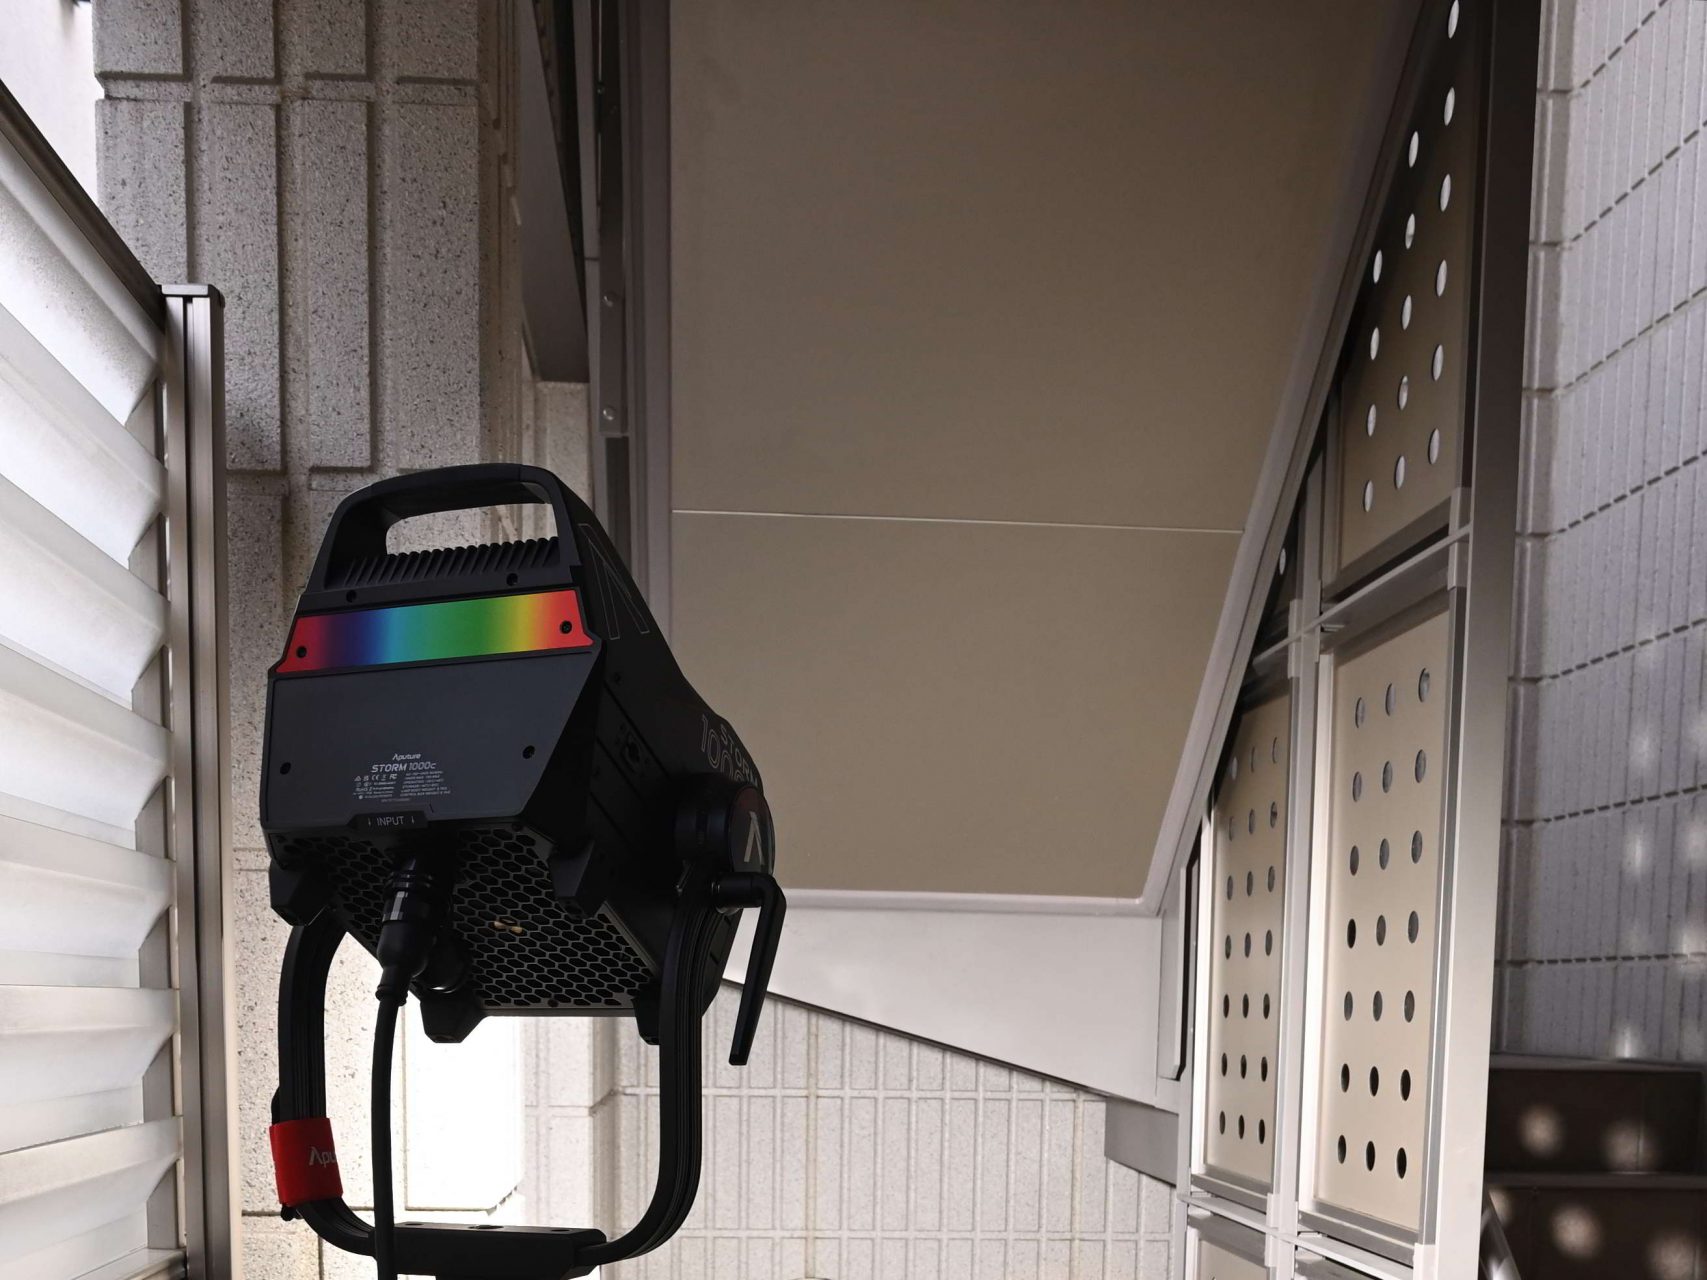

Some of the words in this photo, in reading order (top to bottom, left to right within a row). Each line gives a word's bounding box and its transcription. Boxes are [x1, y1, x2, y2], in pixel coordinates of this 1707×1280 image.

[392, 753, 421, 761] Aputure
[371, 763, 408, 772] STORM
[409, 761, 437, 771] 1000c
[377, 816, 405, 826] INPUT
